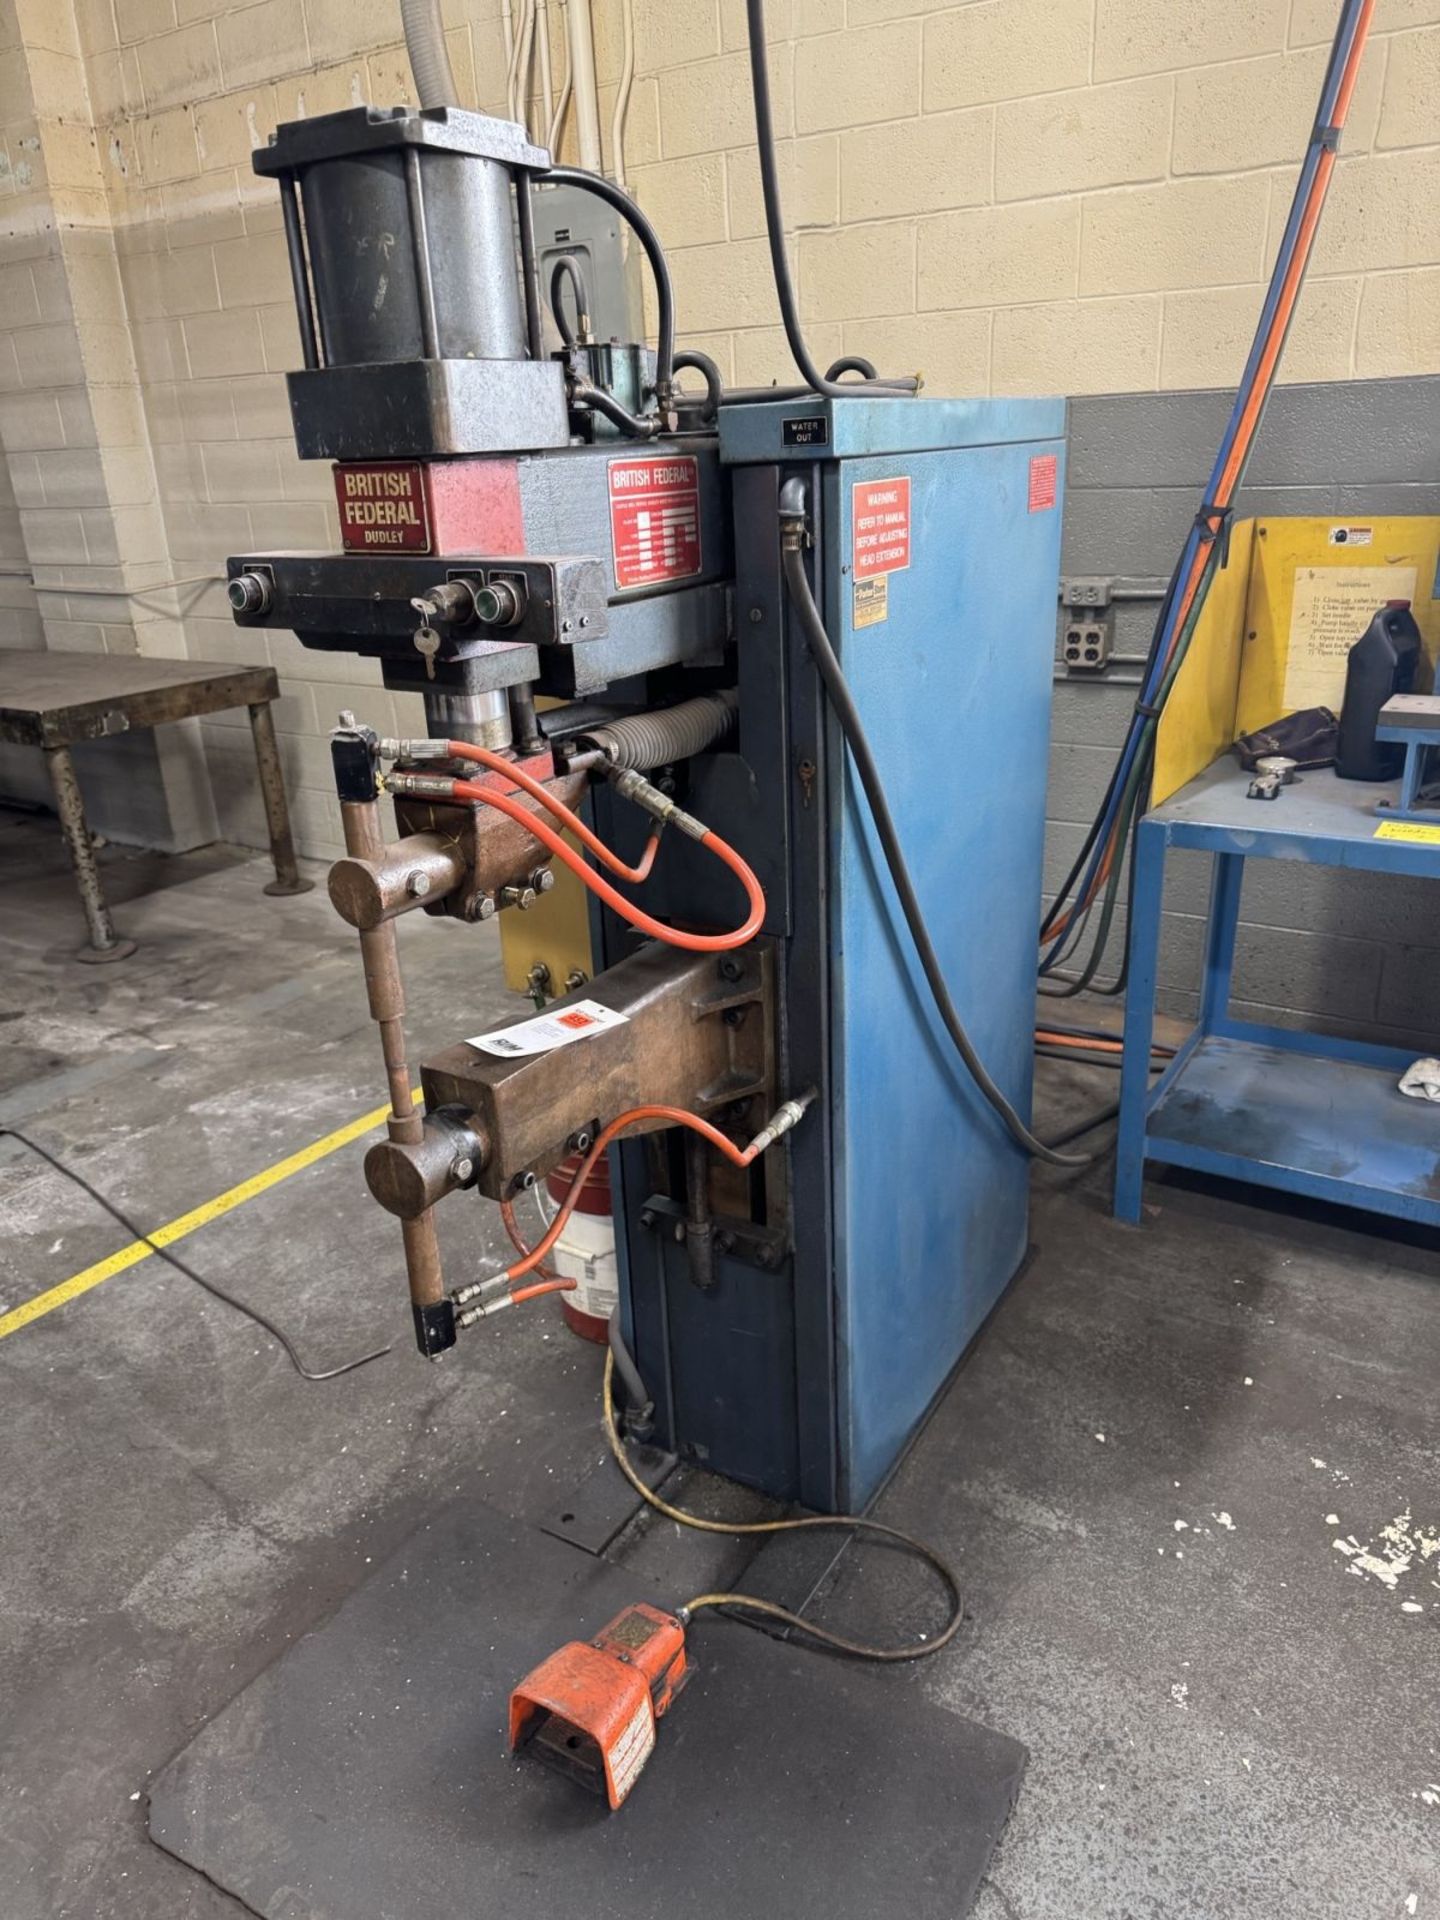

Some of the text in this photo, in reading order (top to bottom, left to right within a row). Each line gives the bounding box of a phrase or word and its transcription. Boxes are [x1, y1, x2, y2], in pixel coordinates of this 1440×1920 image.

[791, 421, 818, 430] WATER
[796, 432, 811, 442] OUT
[344, 472, 412, 497] BRITISH
[613, 465, 690, 489] BRITISH FEDERAL
[866, 490, 898, 507] WARNING
[344, 501, 420, 525] FEDERAL
[876, 514, 884, 527] TO
[364, 530, 404, 544] DUDLEY
[856, 533, 878, 549] BEFORE
